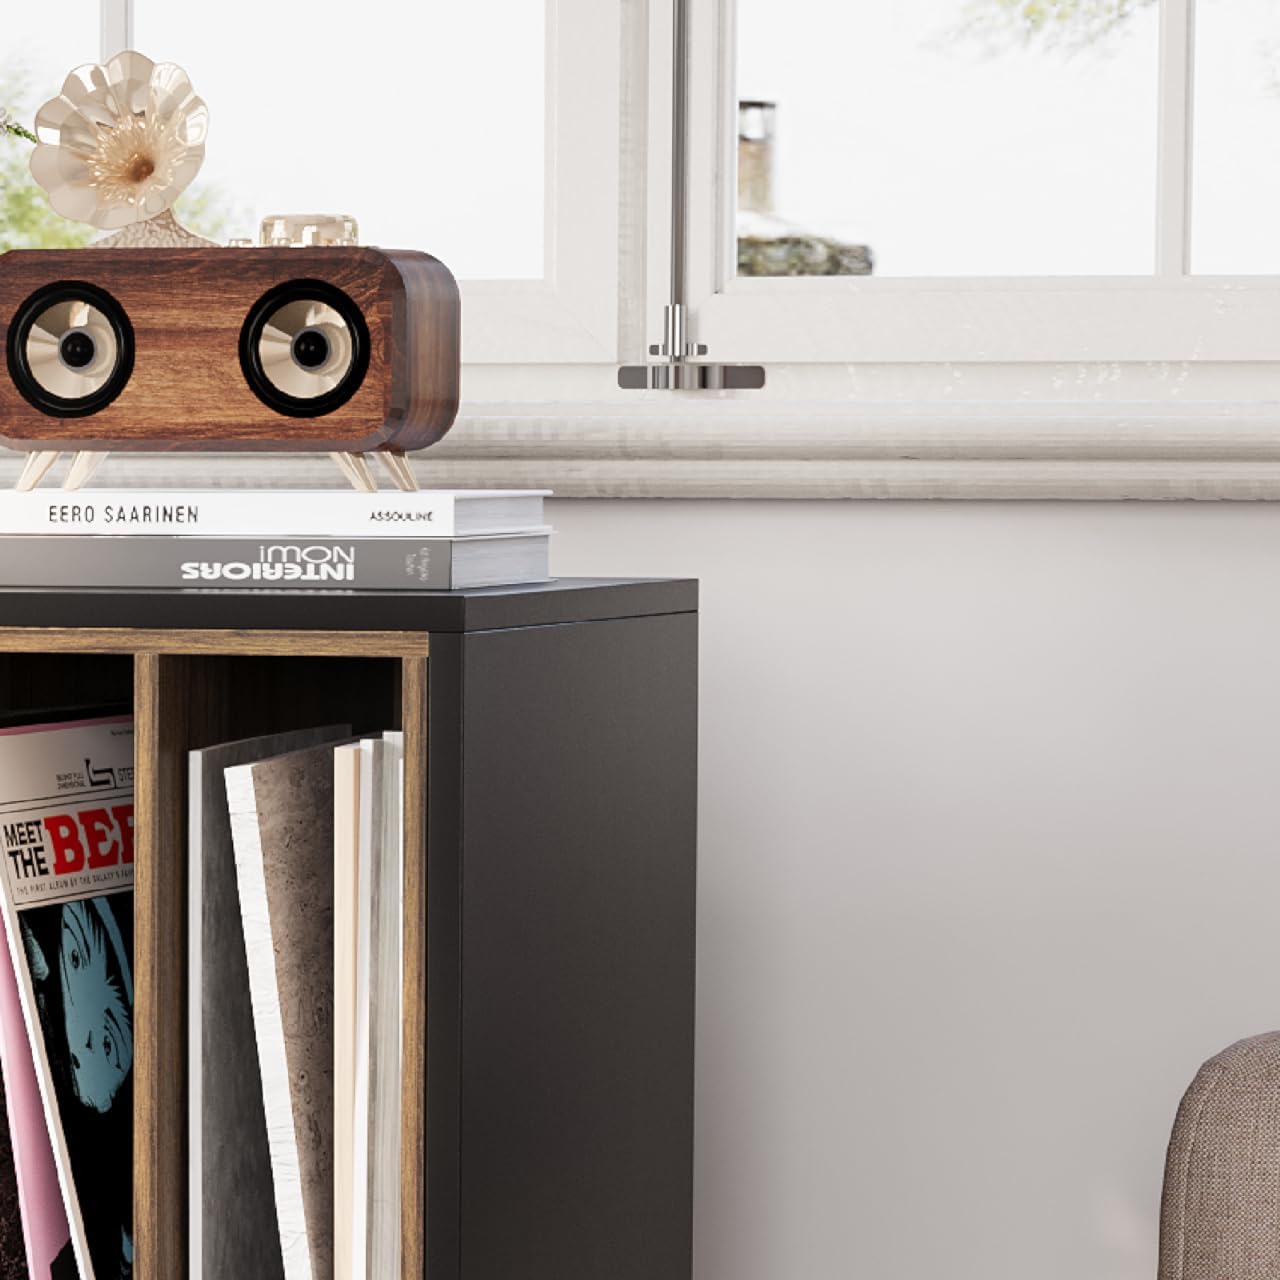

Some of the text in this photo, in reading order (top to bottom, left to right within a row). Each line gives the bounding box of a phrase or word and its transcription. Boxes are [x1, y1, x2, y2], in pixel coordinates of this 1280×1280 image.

[49, 505, 199, 523] EERO SAARINEN
[259, 545, 355, 563] NOW!
[180, 562, 355, 581] INTERIORS
[3, 820, 43, 848] MEET
[7, 846, 50, 880] THE
